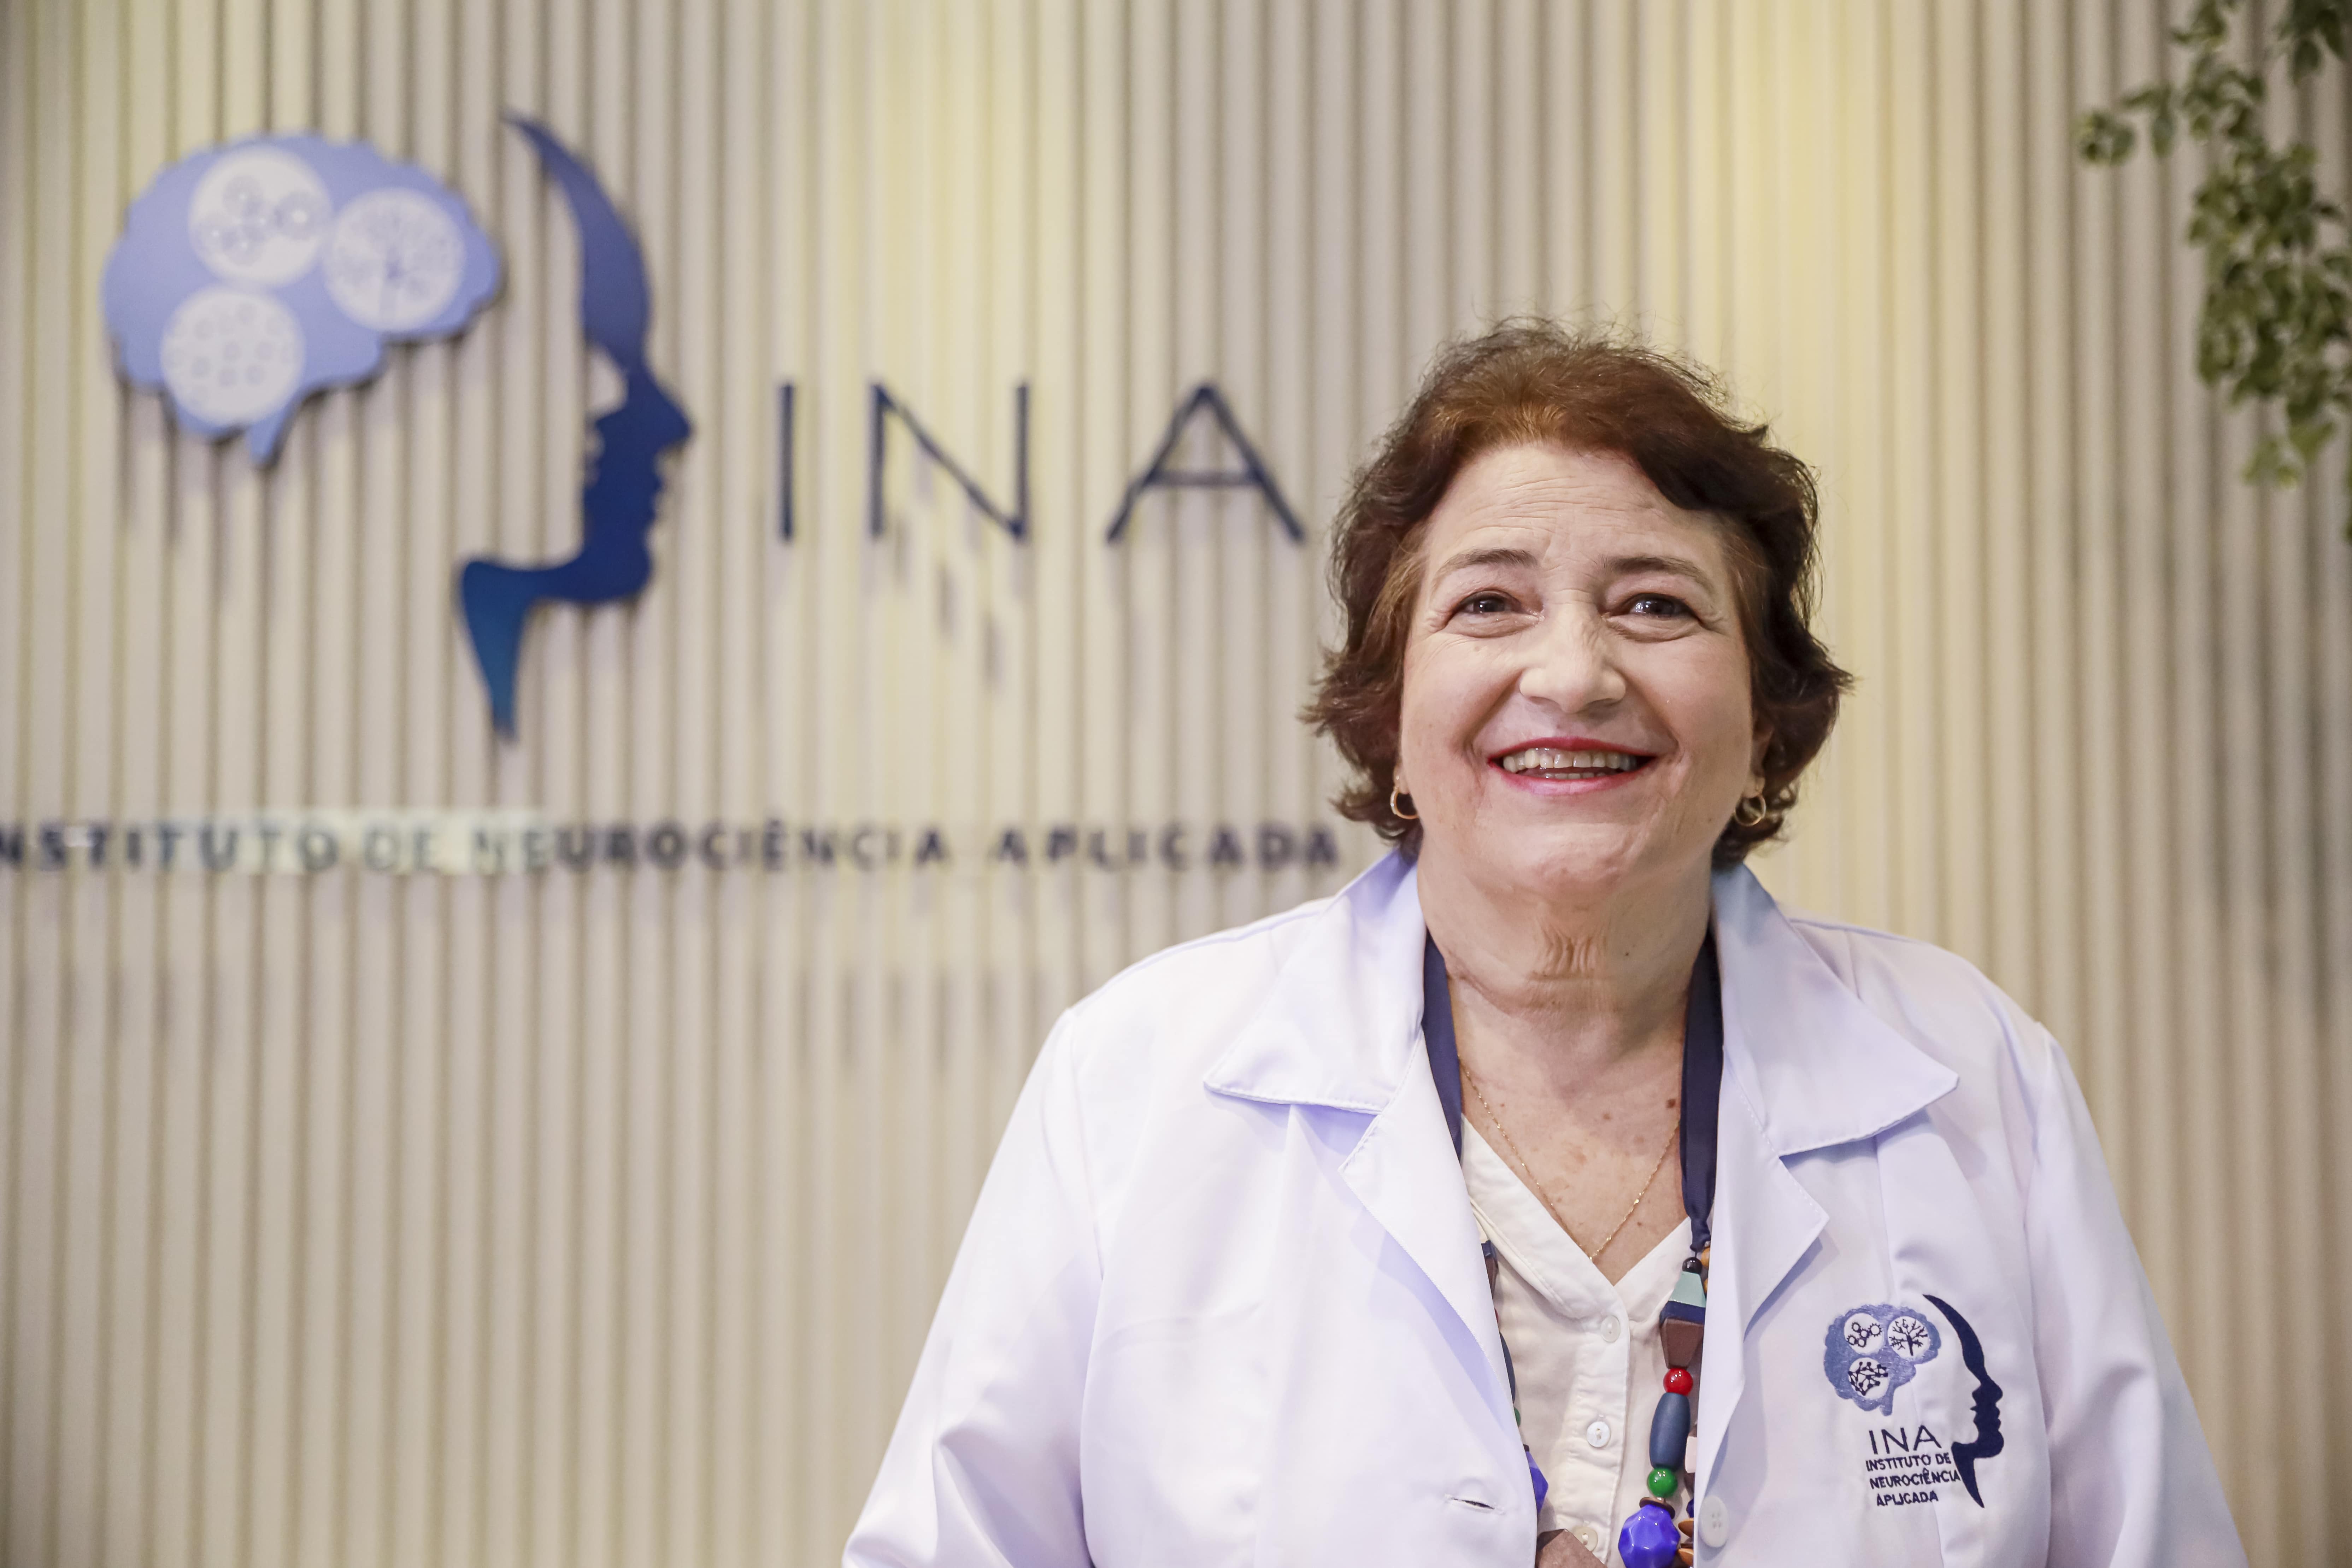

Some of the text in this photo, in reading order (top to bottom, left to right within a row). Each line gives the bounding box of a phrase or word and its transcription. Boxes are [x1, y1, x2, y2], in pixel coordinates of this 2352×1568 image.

[780, 383, 1305, 542] INA
[471, 809, 951, 871] NEUROCIÊNCIA
[994, 822, 1338, 870] APLICADA
[1869, 1425, 1942, 1455] INA
[1865, 1452, 1952, 1472] INSTITUTO DE
[1869, 1468, 1961, 1490] NEUROCIÊNCIA
[1876, 1490, 1939, 1507] APLICADA
